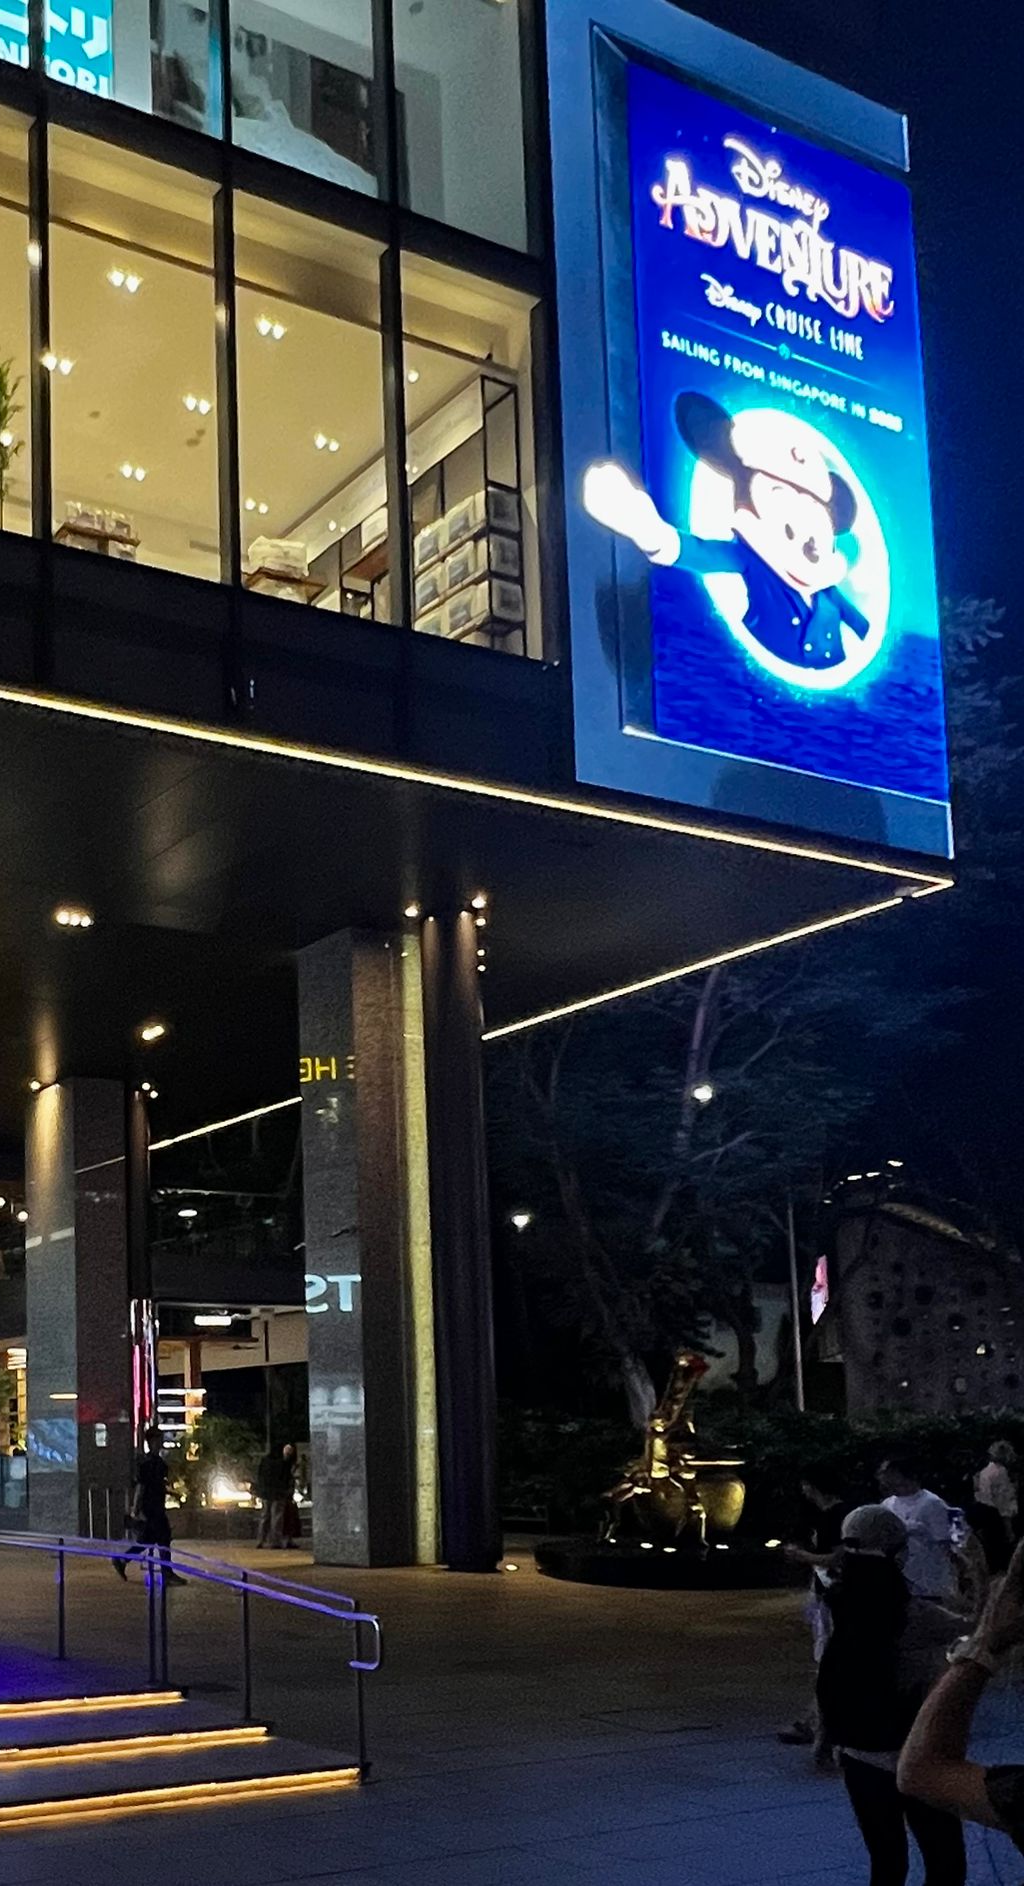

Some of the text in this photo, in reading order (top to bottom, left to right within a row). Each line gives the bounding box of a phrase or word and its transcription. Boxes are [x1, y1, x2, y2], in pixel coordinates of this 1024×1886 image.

[652, 159, 895, 323] ADVENTURE
[700, 273, 864, 361] Disney CRUISE LINE
[661, 331, 720, 367] SAILING
[724, 354, 765, 383] FROM
[768, 371, 847, 413] SINGAPORE
[851, 401, 866, 420] IN
